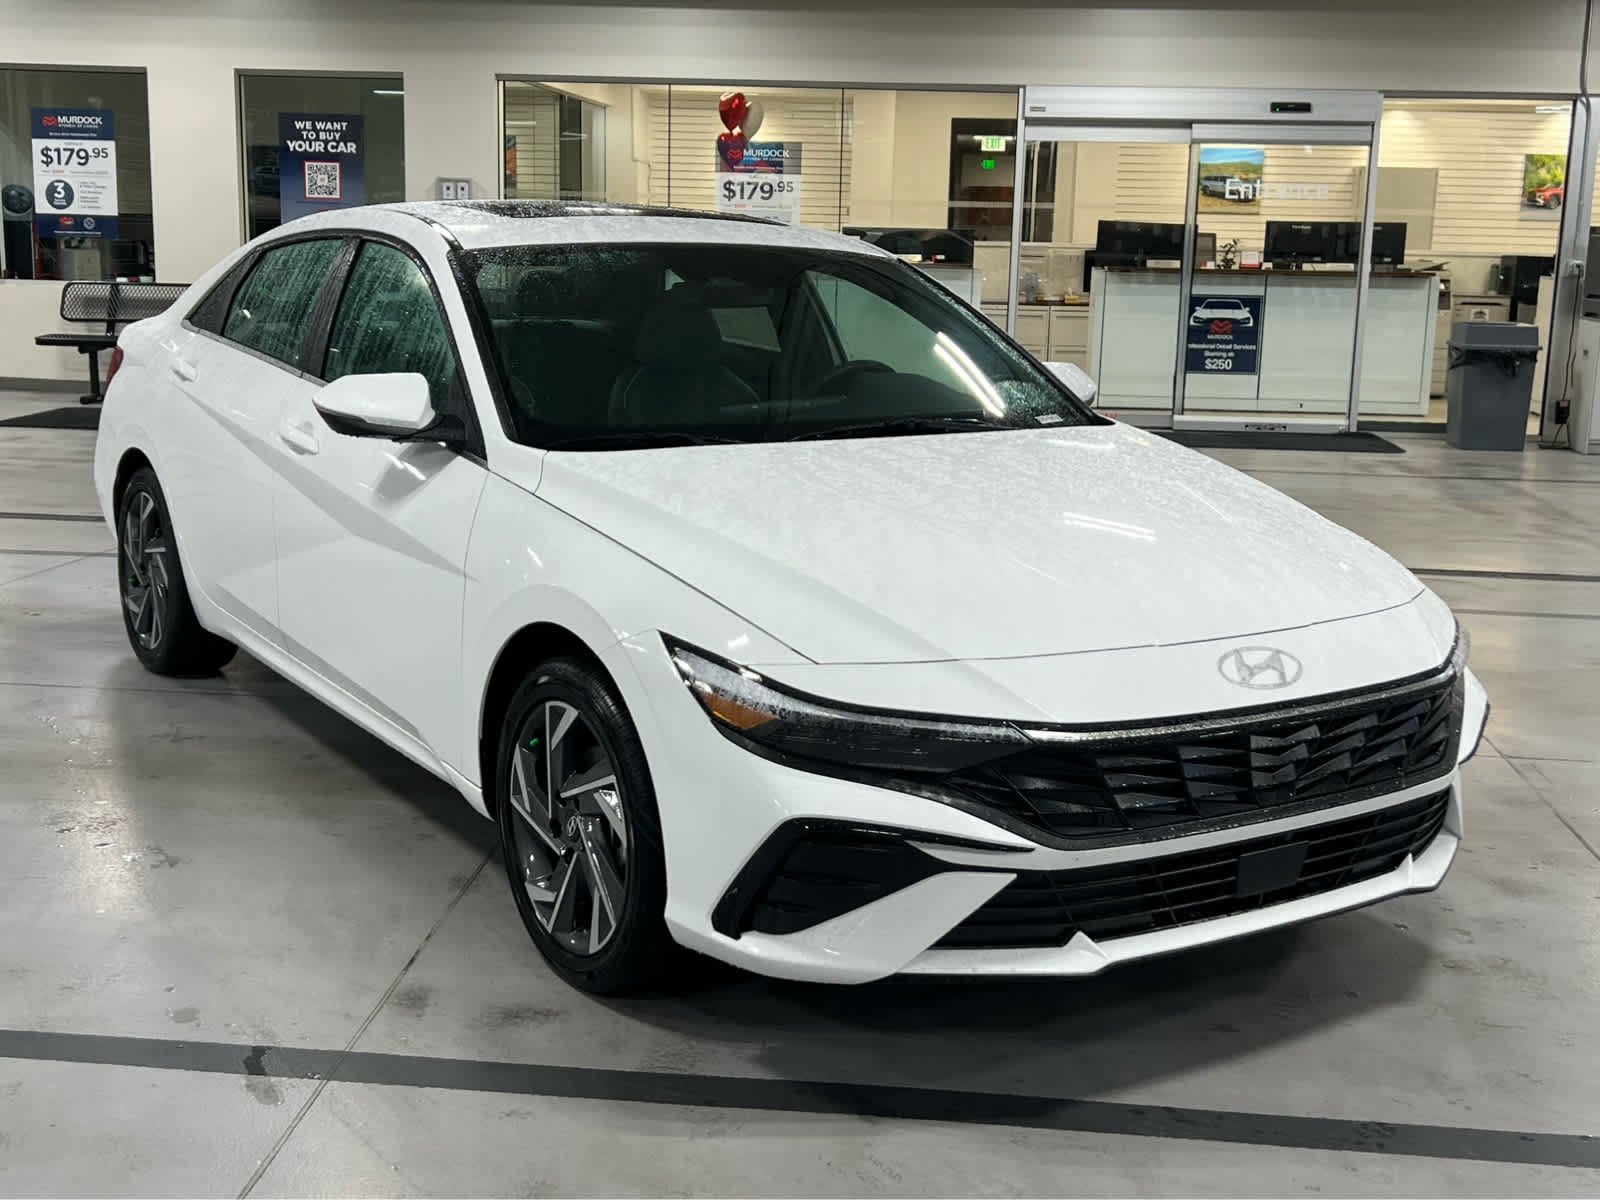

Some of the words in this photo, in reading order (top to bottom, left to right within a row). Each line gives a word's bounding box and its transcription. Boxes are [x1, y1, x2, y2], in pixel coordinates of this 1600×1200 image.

[57, 115, 103, 125] MURDOCK
[294, 121, 313, 130] WE
[315, 121, 348, 131] WANT
[301, 131, 316, 140] TO
[319, 131, 341, 141] BUY
[286, 140, 325, 153] YOUR
[327, 141, 357, 154] CAR
[40, 146, 109, 167] $179.95
[743, 149, 790, 158] MURDOCK
[53, 182, 66, 198] 3
[722, 180, 795, 202] $179.95
[1205, 359, 1233, 370] $250
